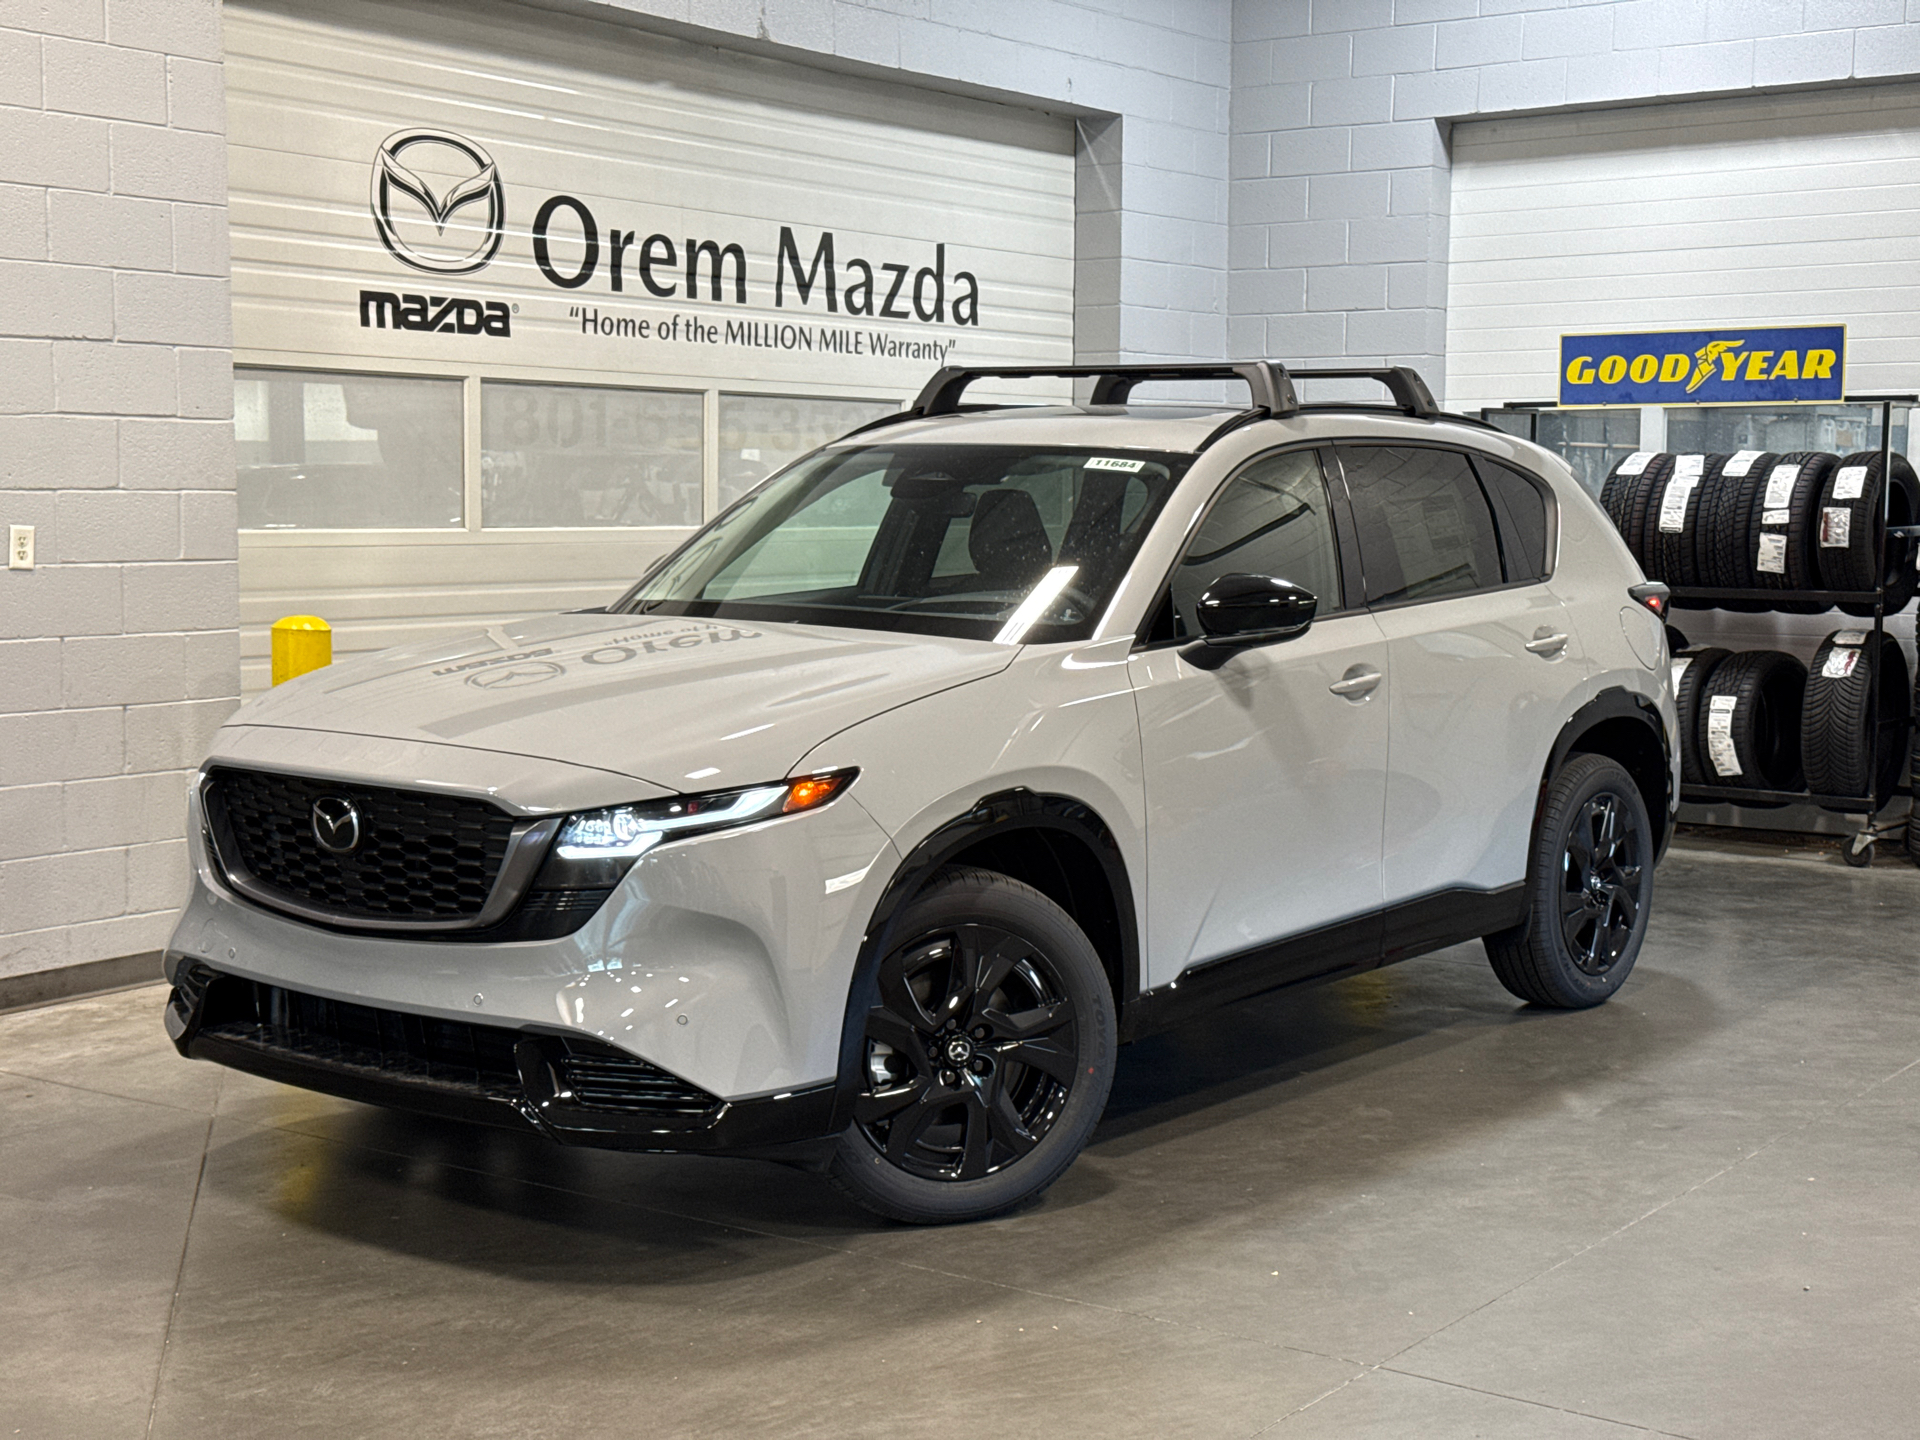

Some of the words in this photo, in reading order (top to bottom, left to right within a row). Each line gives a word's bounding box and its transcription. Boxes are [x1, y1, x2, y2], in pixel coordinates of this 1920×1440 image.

[532, 194, 747, 304] Orem
[774, 226, 980, 328] Mazda
[359, 289, 511, 338] mazda
[569, 306, 650, 339] "Home
[657, 314, 680, 341] of
[685, 316, 718, 344] the
[725, 319, 812, 352] MILLION
[819, 328, 863, 355] MILE
[868, 331, 956, 368] Warranty"
[1096, 460, 1137, 469] 11684
